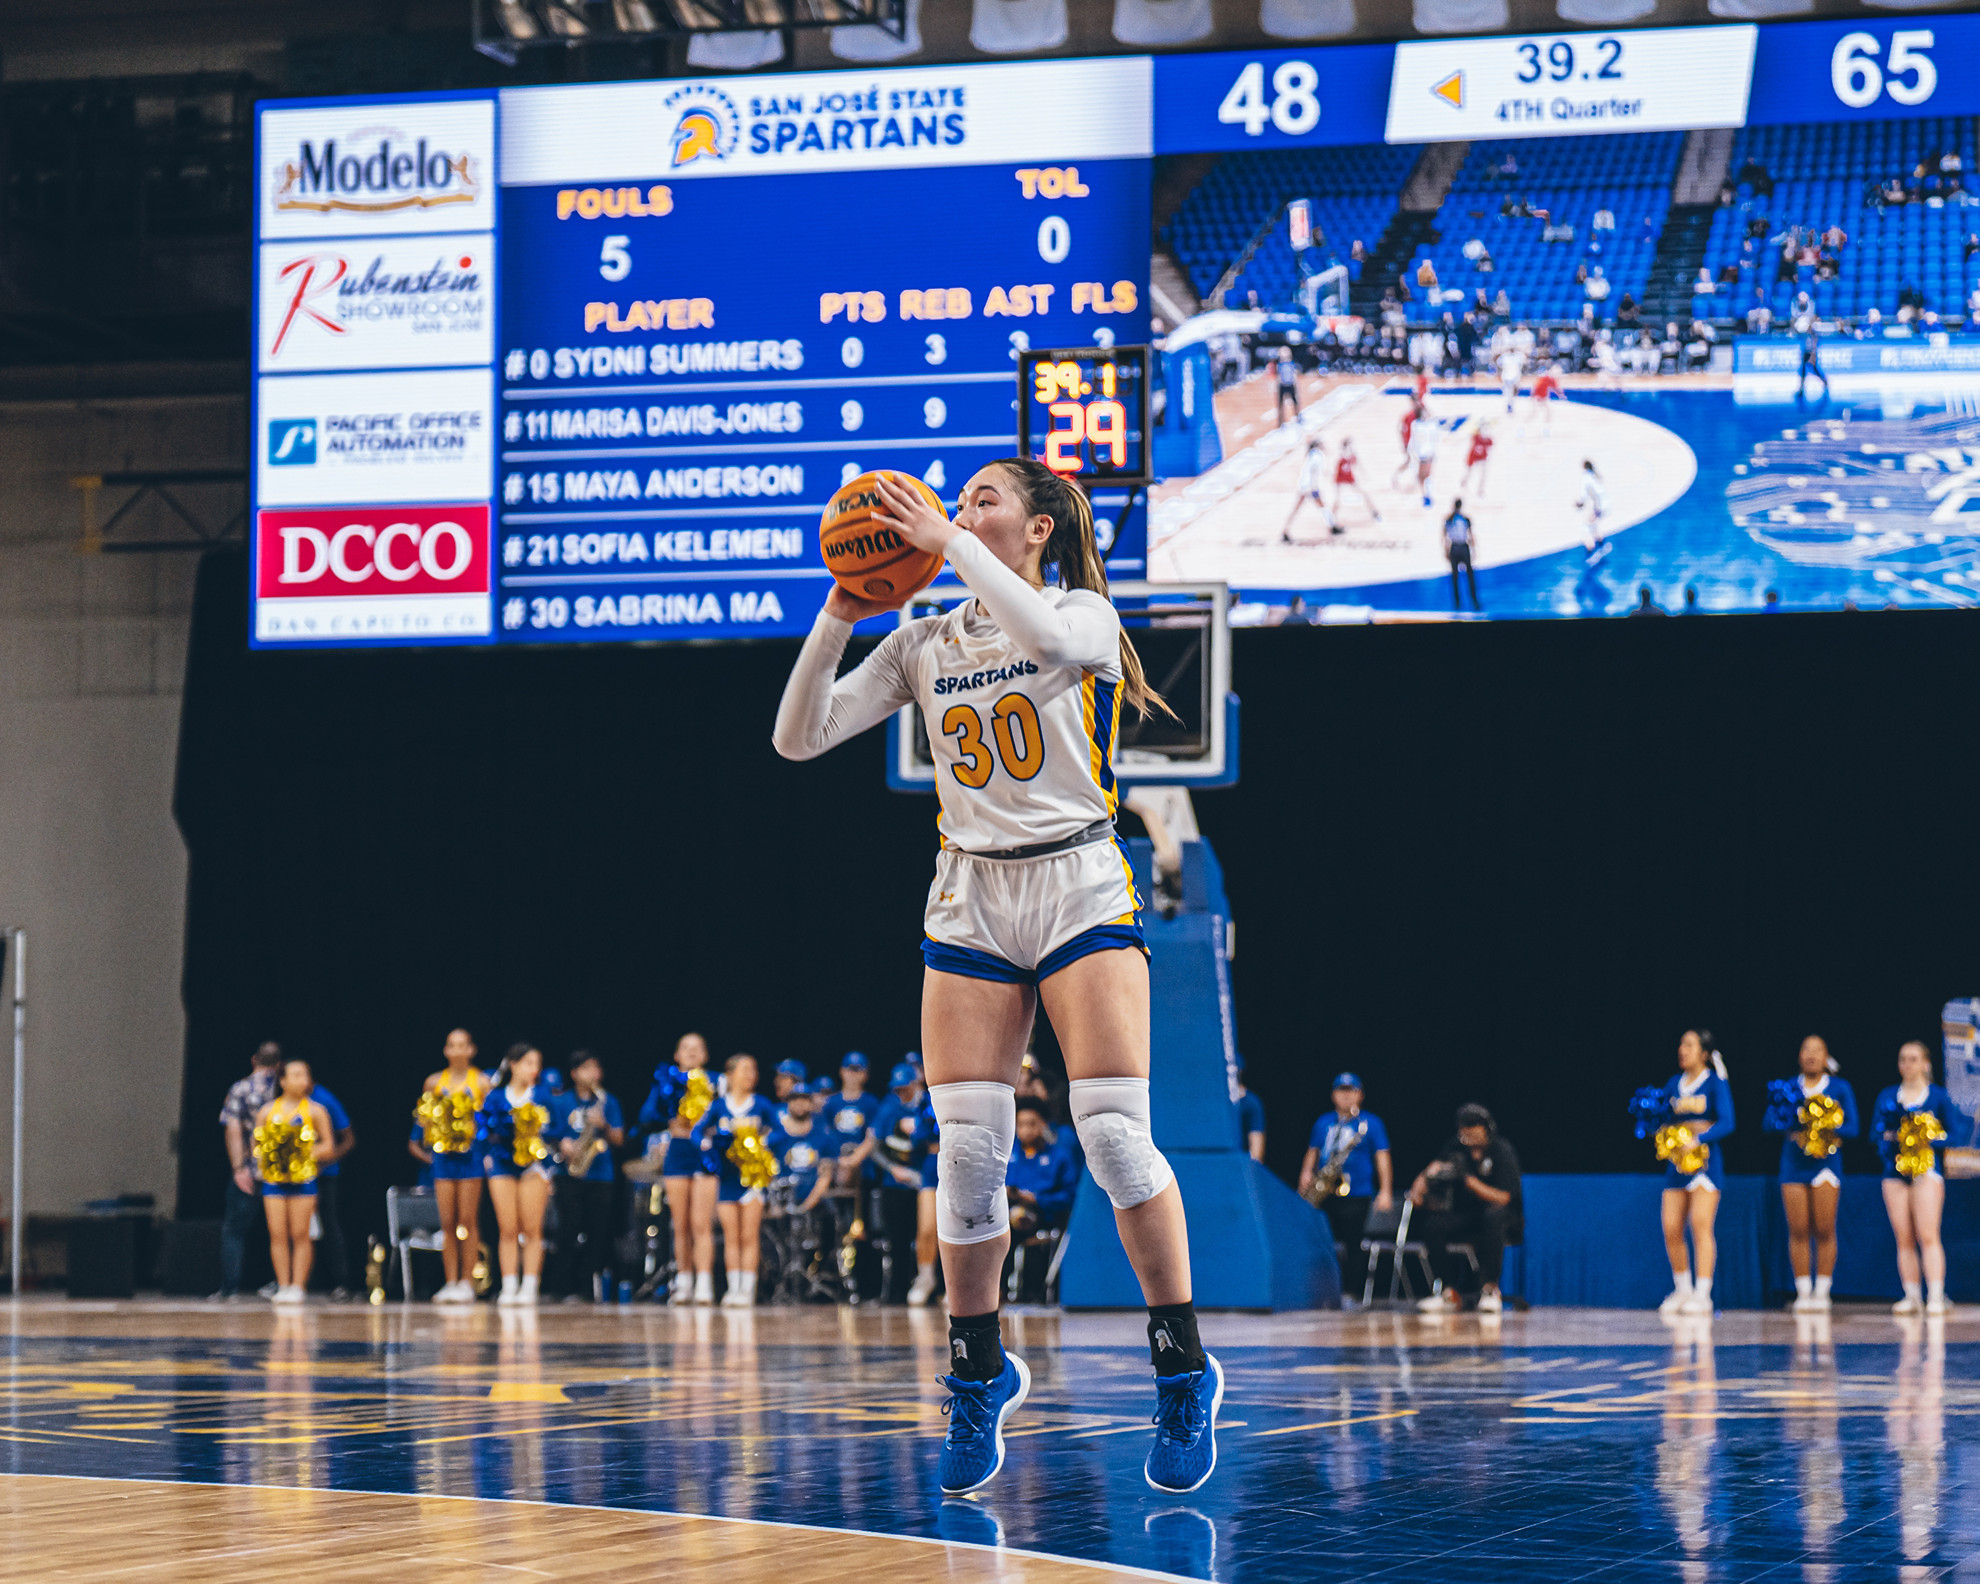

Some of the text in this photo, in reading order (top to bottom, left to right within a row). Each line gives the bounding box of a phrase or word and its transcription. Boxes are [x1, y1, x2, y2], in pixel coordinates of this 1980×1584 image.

[1518, 39, 1622, 83] 39.2
[1831, 29, 1938, 108] 65
[751, 98, 801, 117] SAN
[891, 87, 964, 110] STATE
[1218, 61, 1321, 136] 48
[1496, 96, 1641, 121] 4TH Quarter
[751, 113, 965, 154] SPARTANS
[300, 138, 451, 193] Modelo
[1015, 167, 1090, 199] TOL
[557, 185, 674, 220] FOULS
[600, 235, 632, 282] 5
[1037, 215, 1071, 264] 0
[270, 252, 482, 355] Rubenstein
[336, 299, 483, 321] SHOWROOM
[585, 298, 715, 333] PLAYER
[820, 280, 1138, 324] PTS REB AST FLS
[553, 345, 646, 378] SYDNI
[650, 339, 804, 375] SUMMERS
[841, 337, 864, 368] 0
[925, 333, 947, 365] 3
[1035, 361, 1116, 404] 39.1
[409, 411, 482, 431] OFFICE
[551, 406, 643, 439] MARISA
[646, 401, 803, 437] DAVIS-JONES
[841, 397, 947, 431] 9 9
[327, 433, 465, 452] AUTOMATION
[1046, 401, 1127, 472] 29
[563, 470, 642, 502] MAYA
[644, 465, 804, 499] ANDERSON
[923, 459, 946, 490] 4
[278, 521, 473, 584] DCCO
[561, 532, 650, 566] SOFIA
[653, 528, 803, 562] KELEMENI
[825, 528, 905, 560] Wilson
[573, 592, 724, 626] SABRINA
[729, 590, 784, 623] MA
[934, 660, 1039, 695] SPARTANS
[942, 691, 1046, 789] 30
